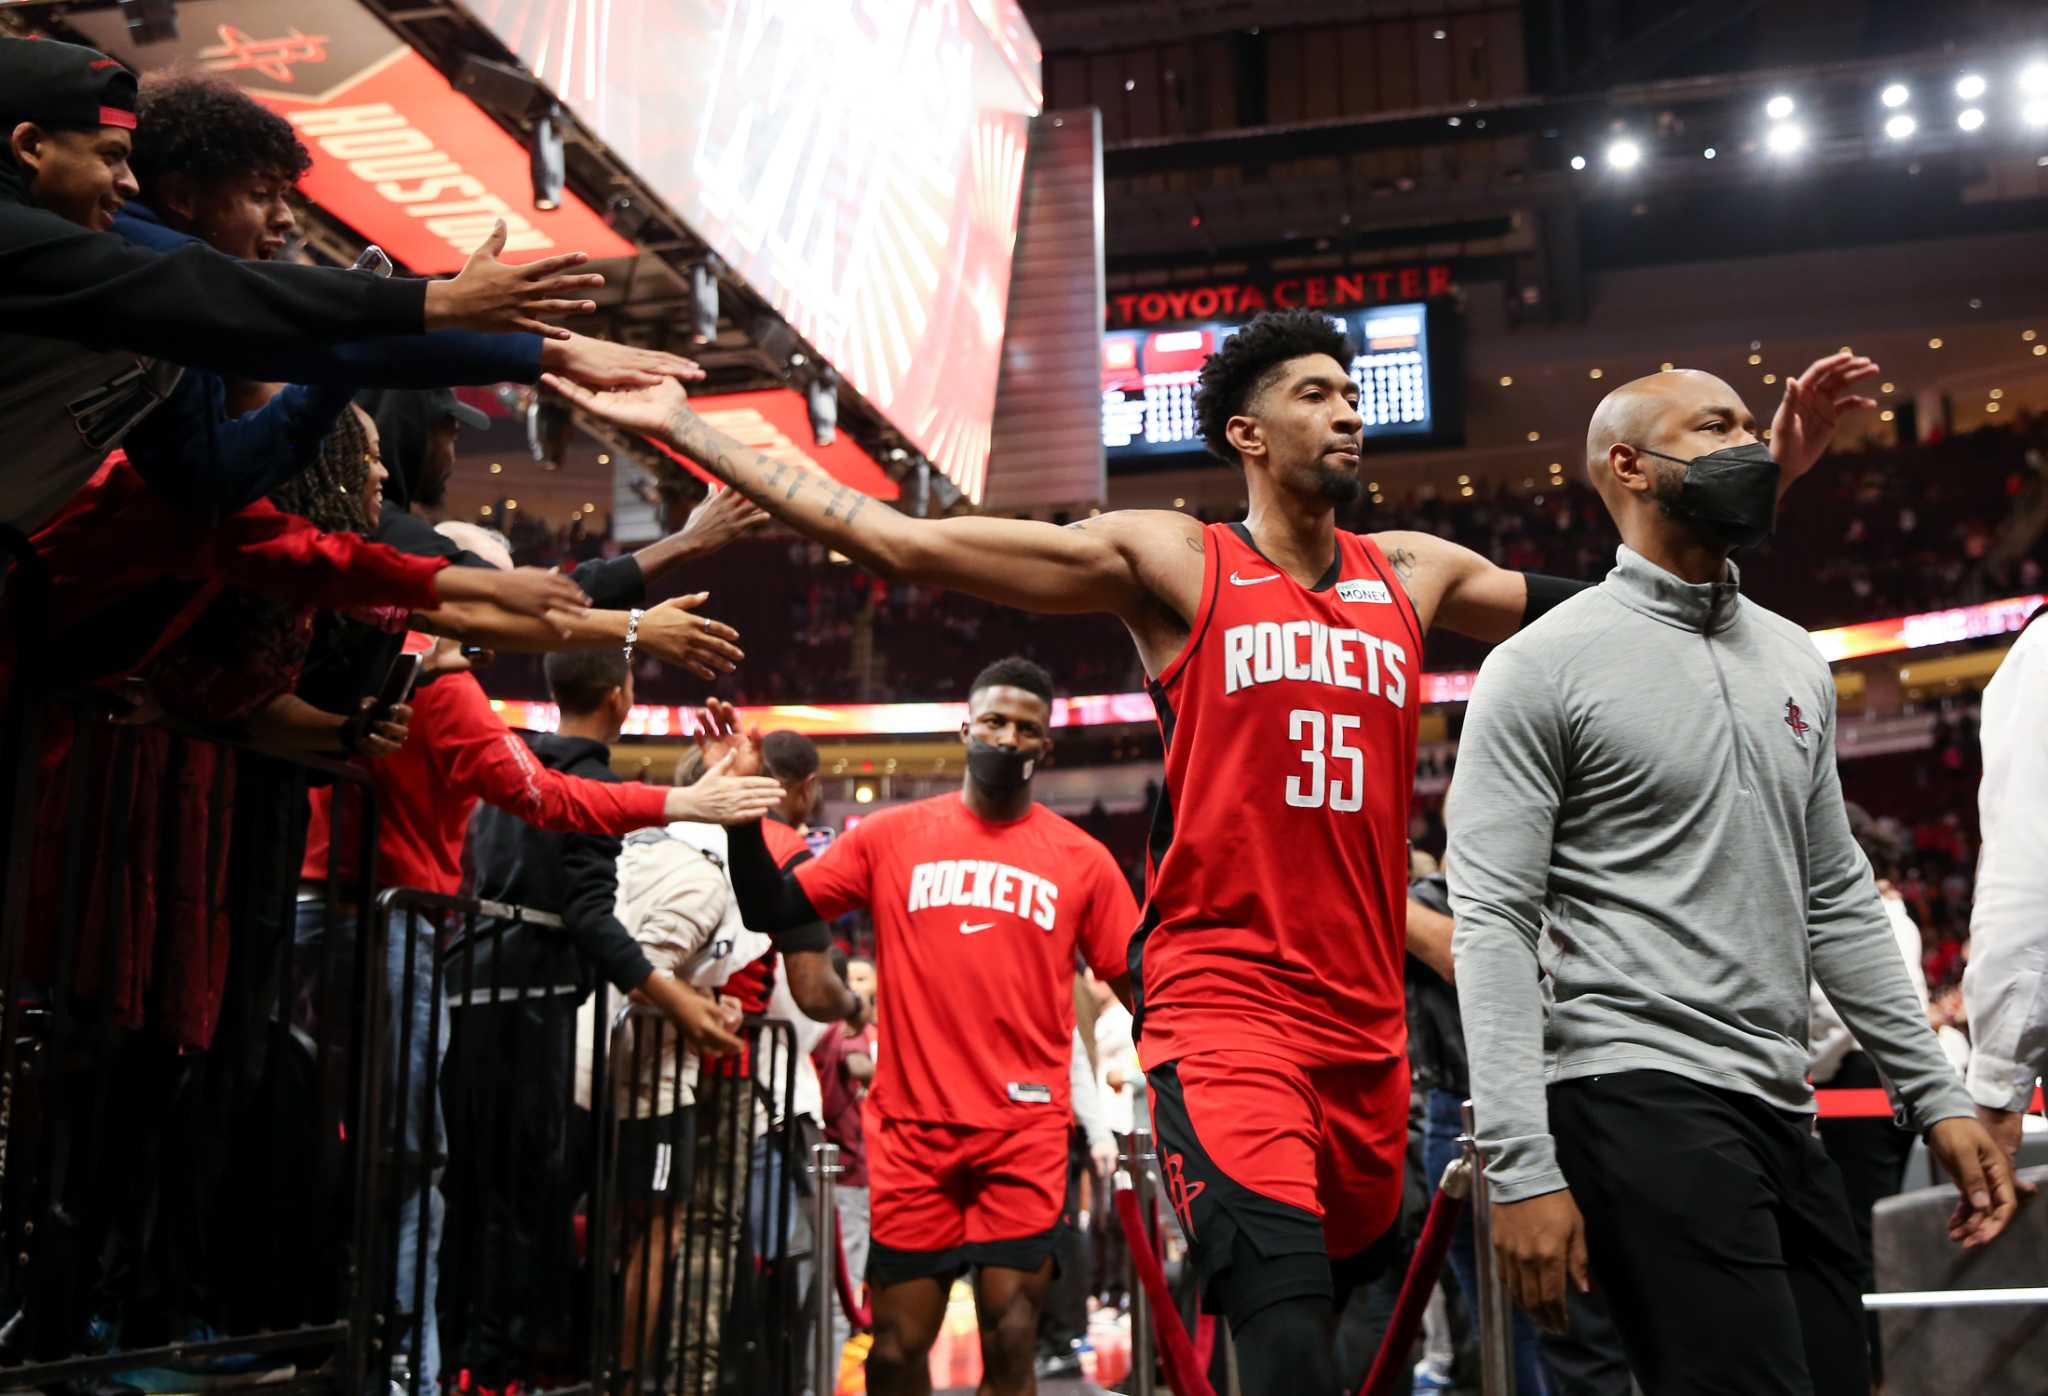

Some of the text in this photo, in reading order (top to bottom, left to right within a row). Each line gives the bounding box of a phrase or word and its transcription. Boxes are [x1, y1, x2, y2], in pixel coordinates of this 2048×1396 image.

[1118, 265, 1451, 323] TOYOTA CENTER
[1340, 589, 1387, 601] MONEY
[1224, 620, 1407, 709] ROCKETS
[1285, 708, 1365, 813] 35
[908, 859, 1059, 931] ROCKETS
